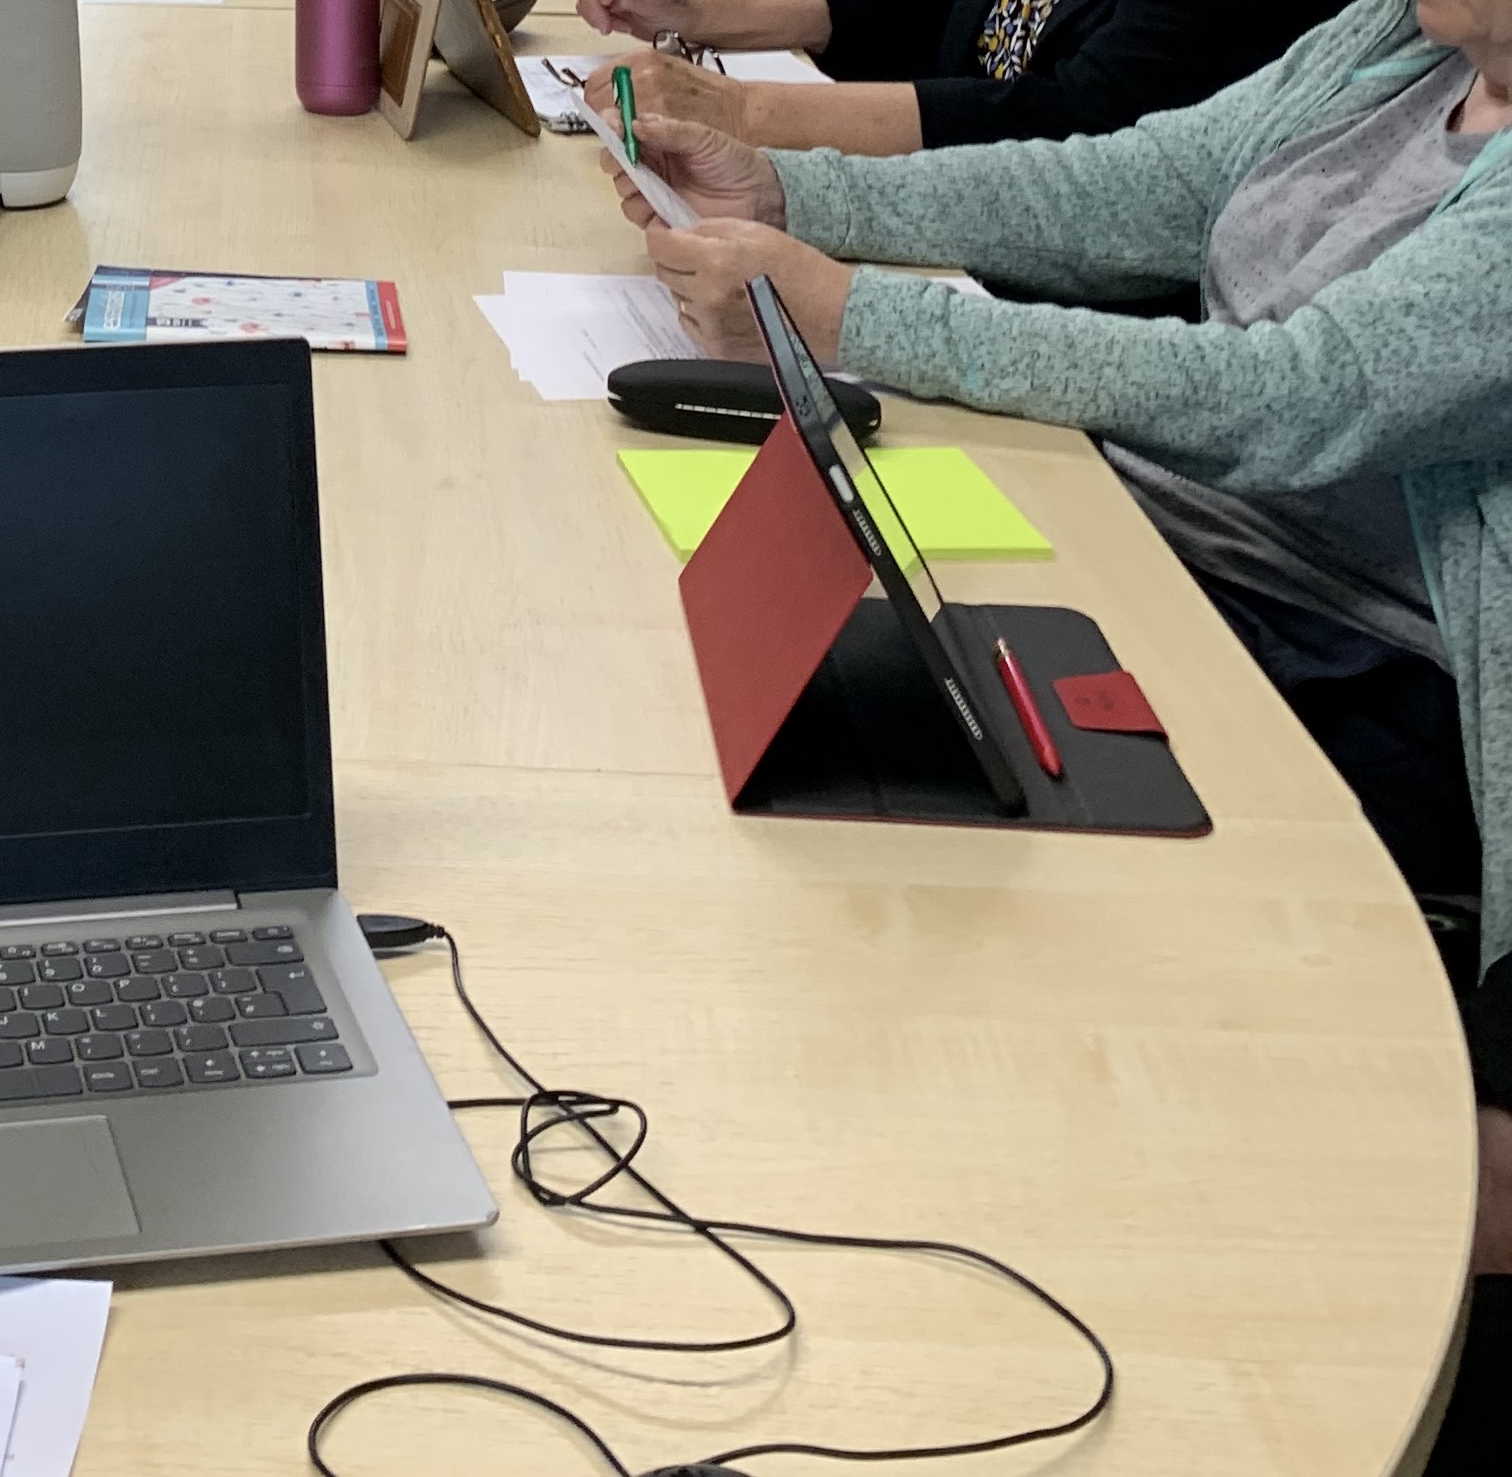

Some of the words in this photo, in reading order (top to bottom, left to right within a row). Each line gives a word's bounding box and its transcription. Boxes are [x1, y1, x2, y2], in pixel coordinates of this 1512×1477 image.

[71, 982, 86, 993] O
[0, 1015, 8, 1026] J
[46, 1011, 60, 1021] K
[30, 1041, 46, 1050] M
